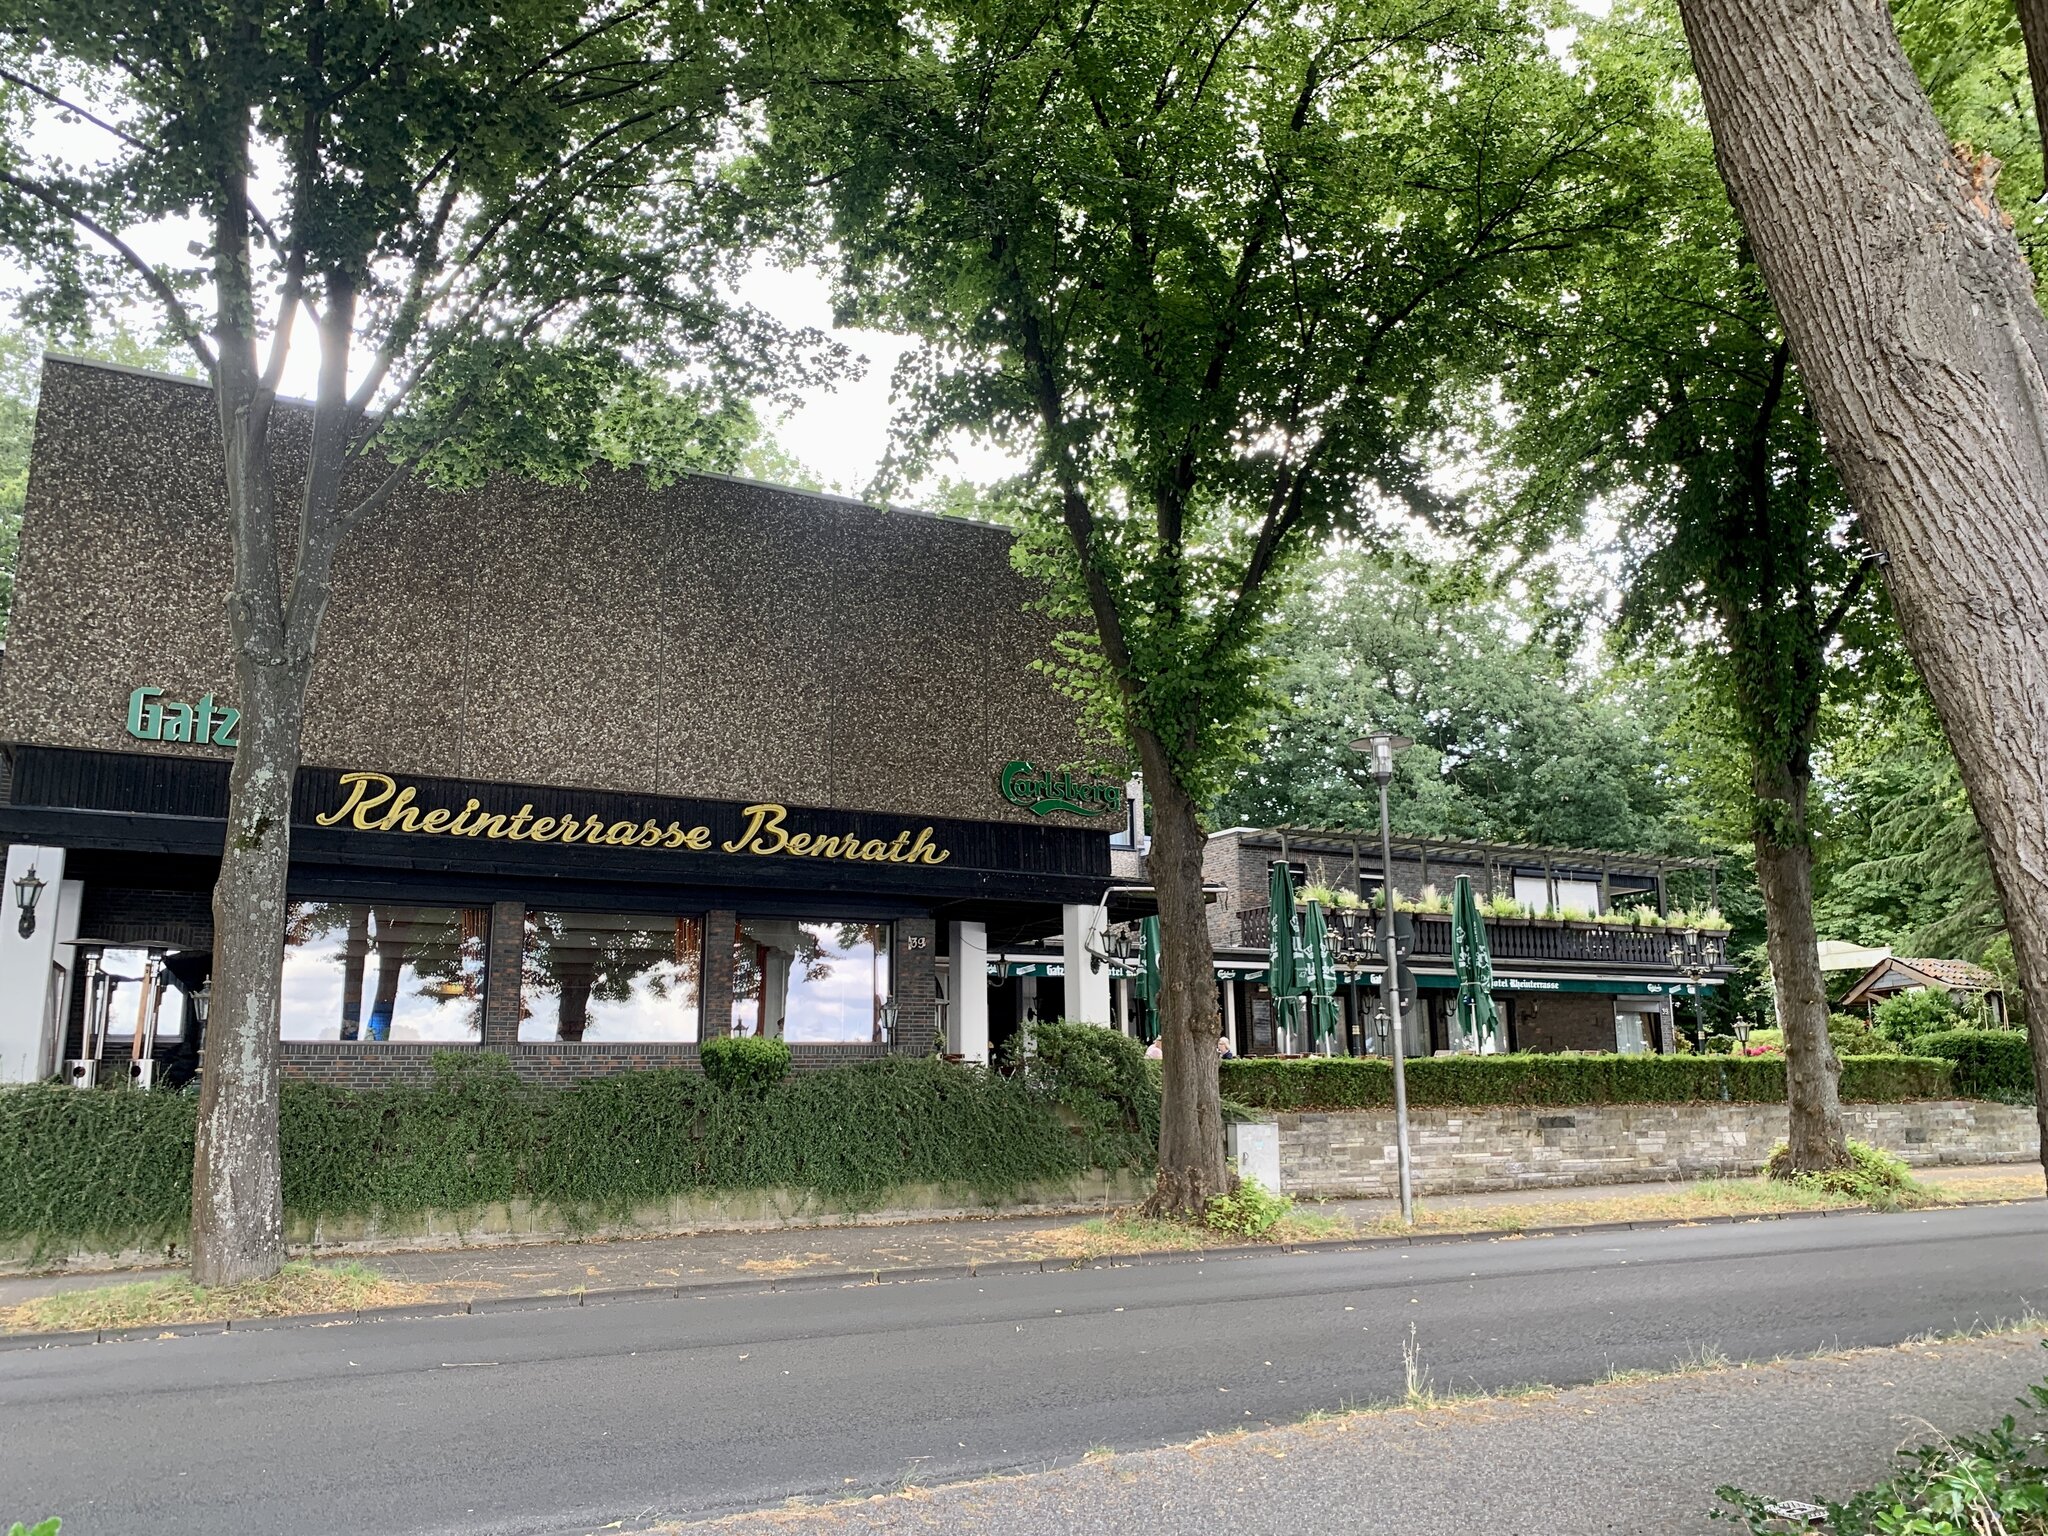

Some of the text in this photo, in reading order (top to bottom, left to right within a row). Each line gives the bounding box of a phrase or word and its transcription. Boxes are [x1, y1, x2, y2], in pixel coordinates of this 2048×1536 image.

[127, 686, 240, 747] Gatz
[315, 771, 950, 864] Rheinterrasse Benrath
[1002, 760, 1121, 816] Carlsberg
